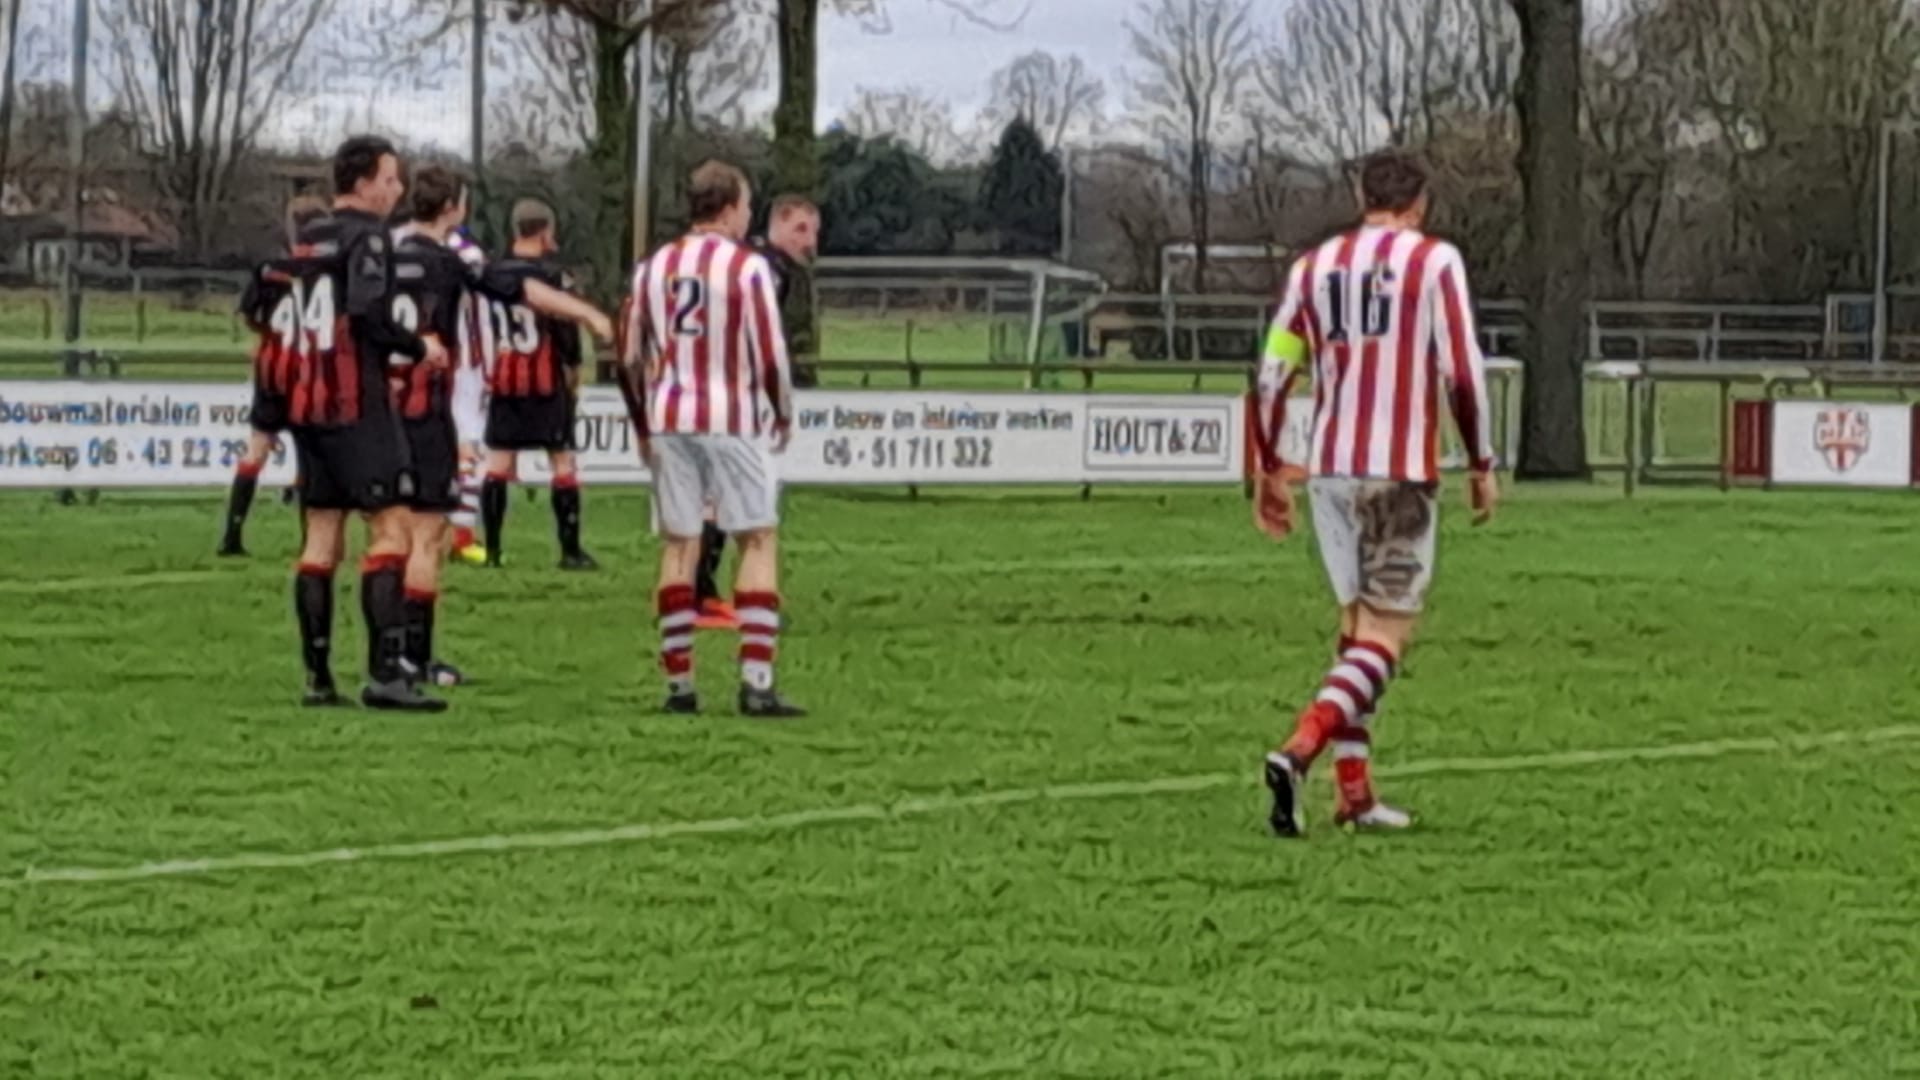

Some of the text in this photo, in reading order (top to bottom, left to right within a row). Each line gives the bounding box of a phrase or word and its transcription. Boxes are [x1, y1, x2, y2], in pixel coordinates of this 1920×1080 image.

[671, 276, 704, 336] 2
[1327, 262, 1395, 340] 16
[491, 300, 539, 355] 13
[0, 394, 200, 426] bouwmaterialen
[833, 404, 886, 430] bouw
[88, 437, 118, 467] 06
[142, 436, 172, 467] 43
[182, 438, 210, 468] 22
[571, 414, 634, 454] OUT
[871, 436, 897, 468] 51
[906, 436, 945, 469] 711
